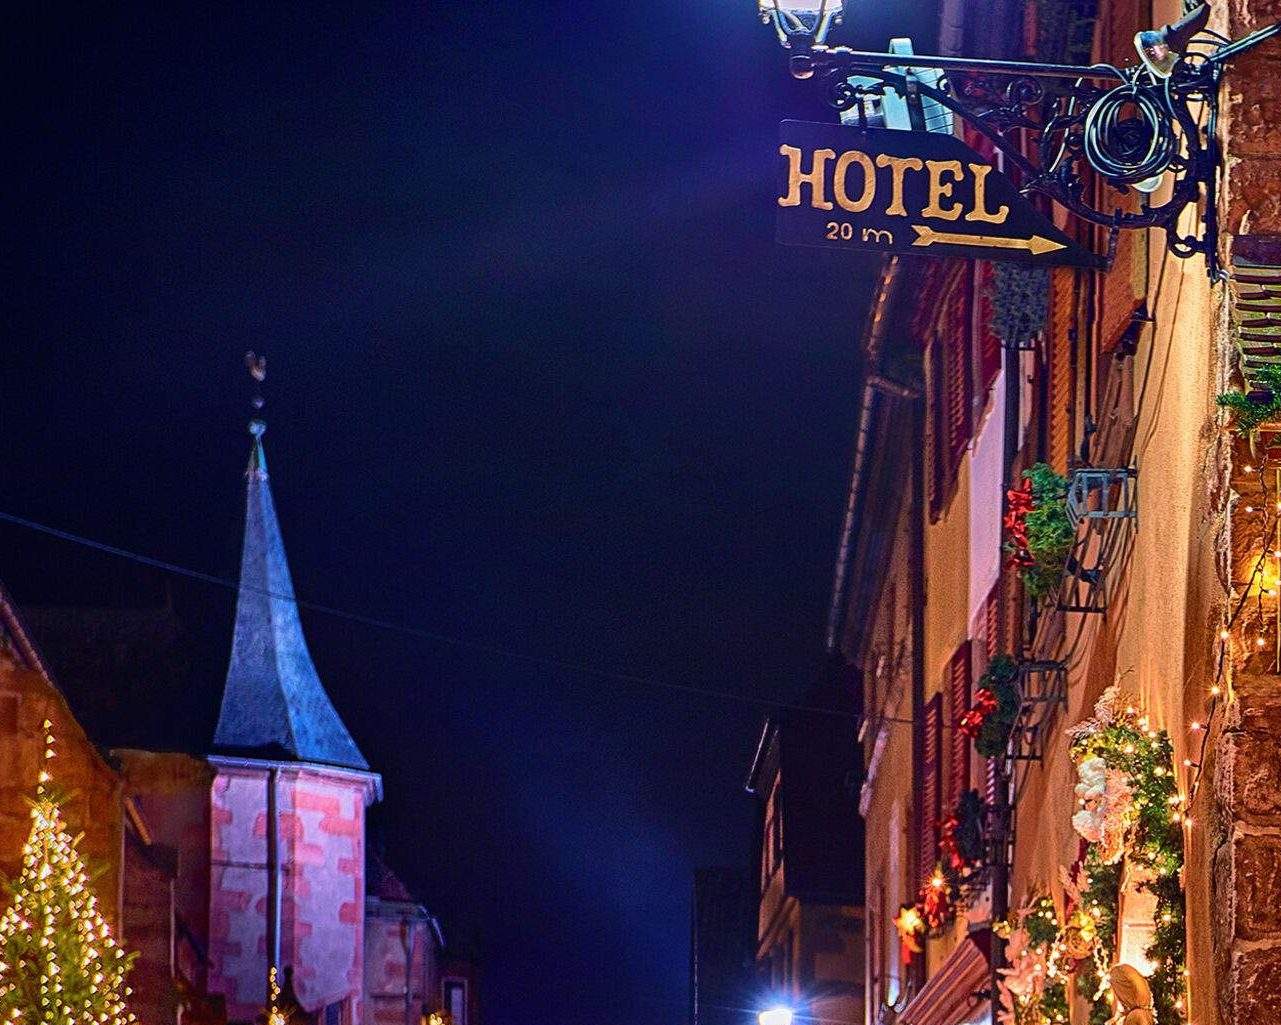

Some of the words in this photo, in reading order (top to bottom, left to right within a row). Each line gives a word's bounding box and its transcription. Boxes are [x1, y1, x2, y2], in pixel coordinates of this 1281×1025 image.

[778, 144, 1010, 224] HOTEL
[826, 222, 853, 240] 20
[862, 227, 894, 244] m
